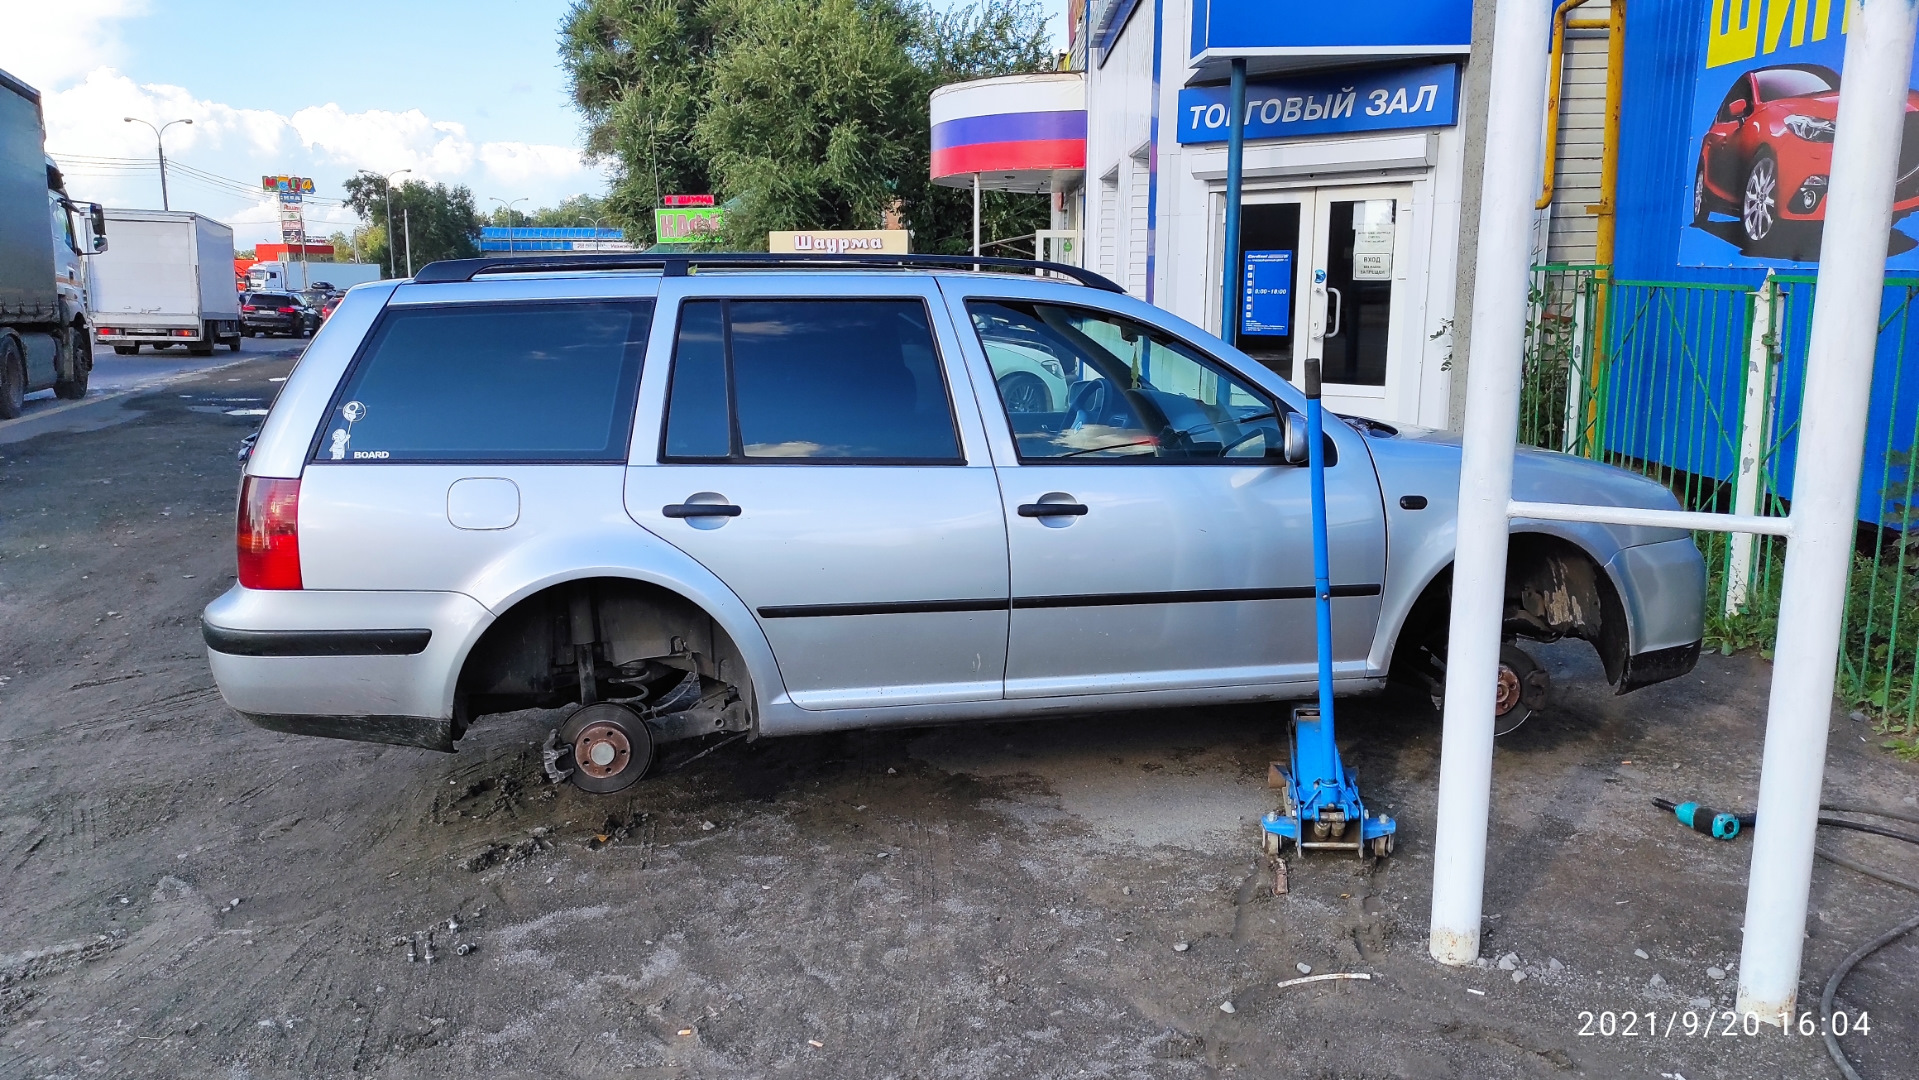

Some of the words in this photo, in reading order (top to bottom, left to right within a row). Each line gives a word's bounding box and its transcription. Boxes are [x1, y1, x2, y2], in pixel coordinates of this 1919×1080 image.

[1190, 86, 1356, 130] ТОГОВЫЙ
[1365, 84, 1438, 117] ЗАЛ
[794, 235, 882, 253] Шаурма
[353, 451, 390, 459] BOARD
